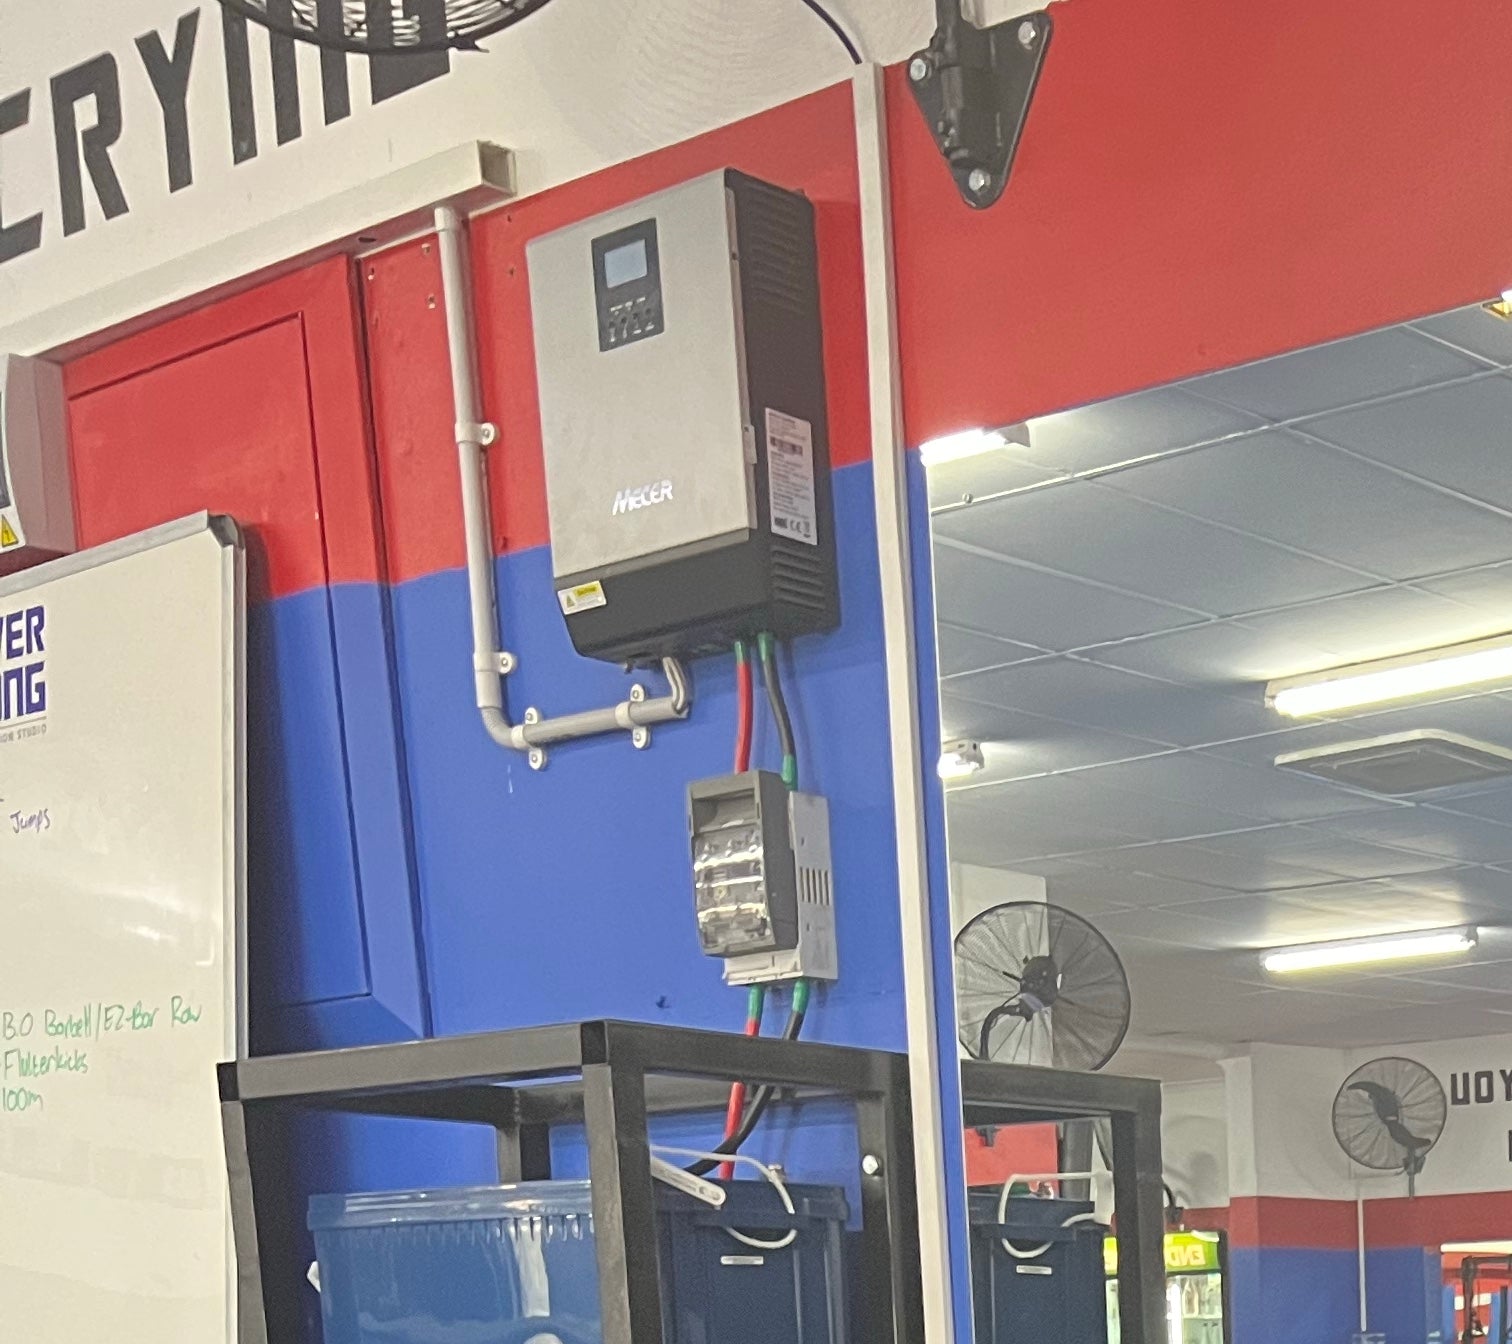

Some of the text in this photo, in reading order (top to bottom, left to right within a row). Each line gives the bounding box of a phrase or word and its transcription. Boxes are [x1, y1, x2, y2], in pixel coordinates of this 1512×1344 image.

[611, 479, 674, 516] MECER
[0, 605, 45, 660] ER
[0, 660, 46, 721] NG
